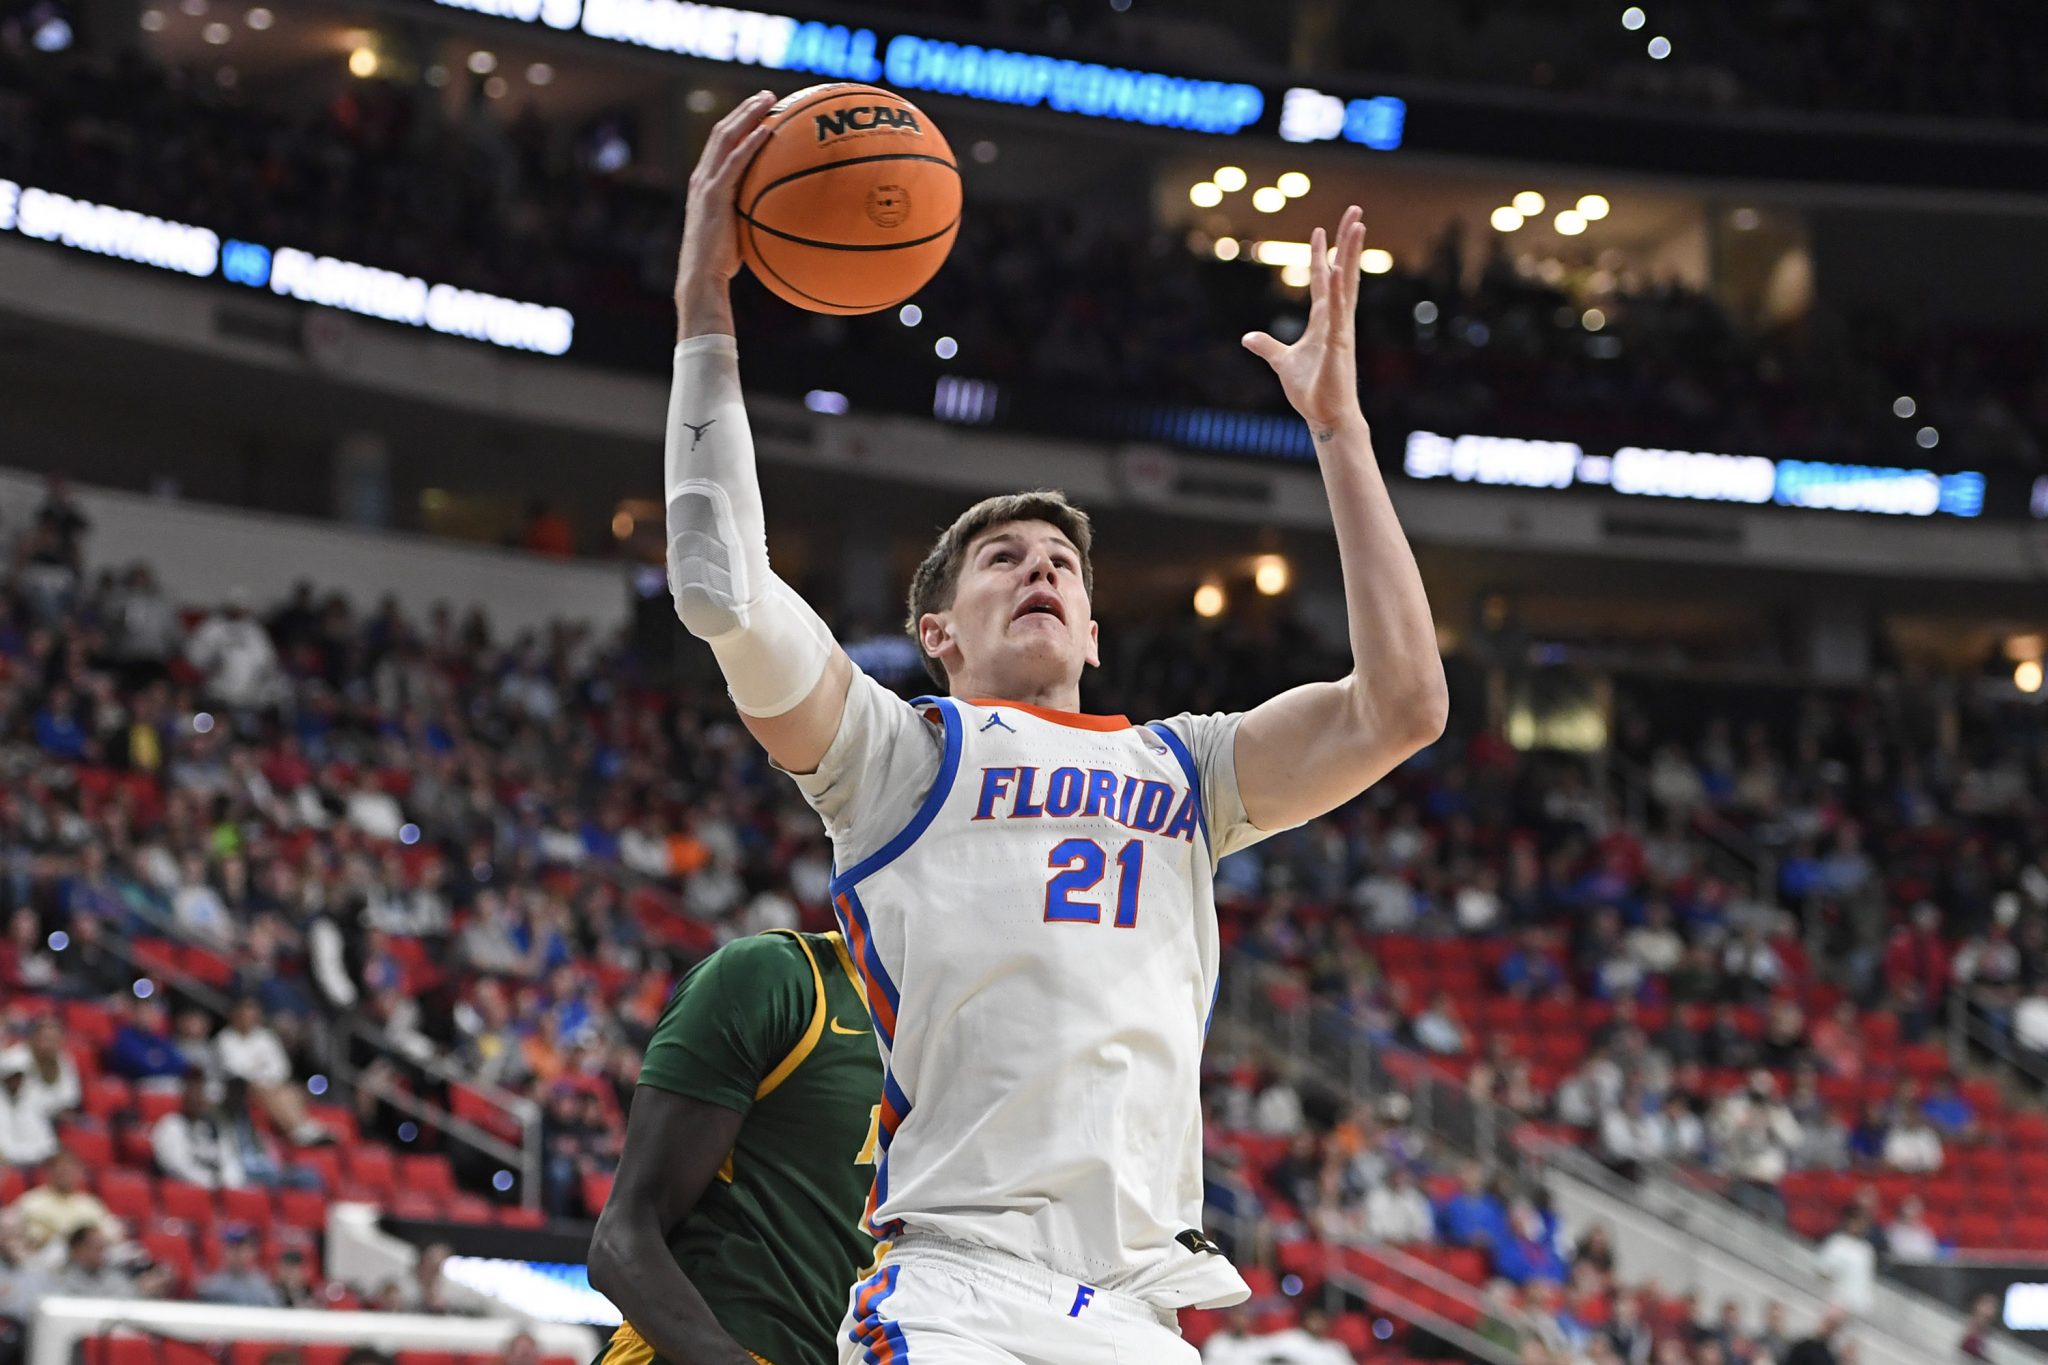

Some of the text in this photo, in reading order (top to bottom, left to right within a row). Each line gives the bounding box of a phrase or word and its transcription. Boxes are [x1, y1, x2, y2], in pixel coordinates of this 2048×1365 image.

[814, 106, 923, 142] NCAA
[971, 766, 1200, 843] FLORIDA
[1043, 838, 1144, 928] 21
[1067, 1282, 1095, 1317] F
